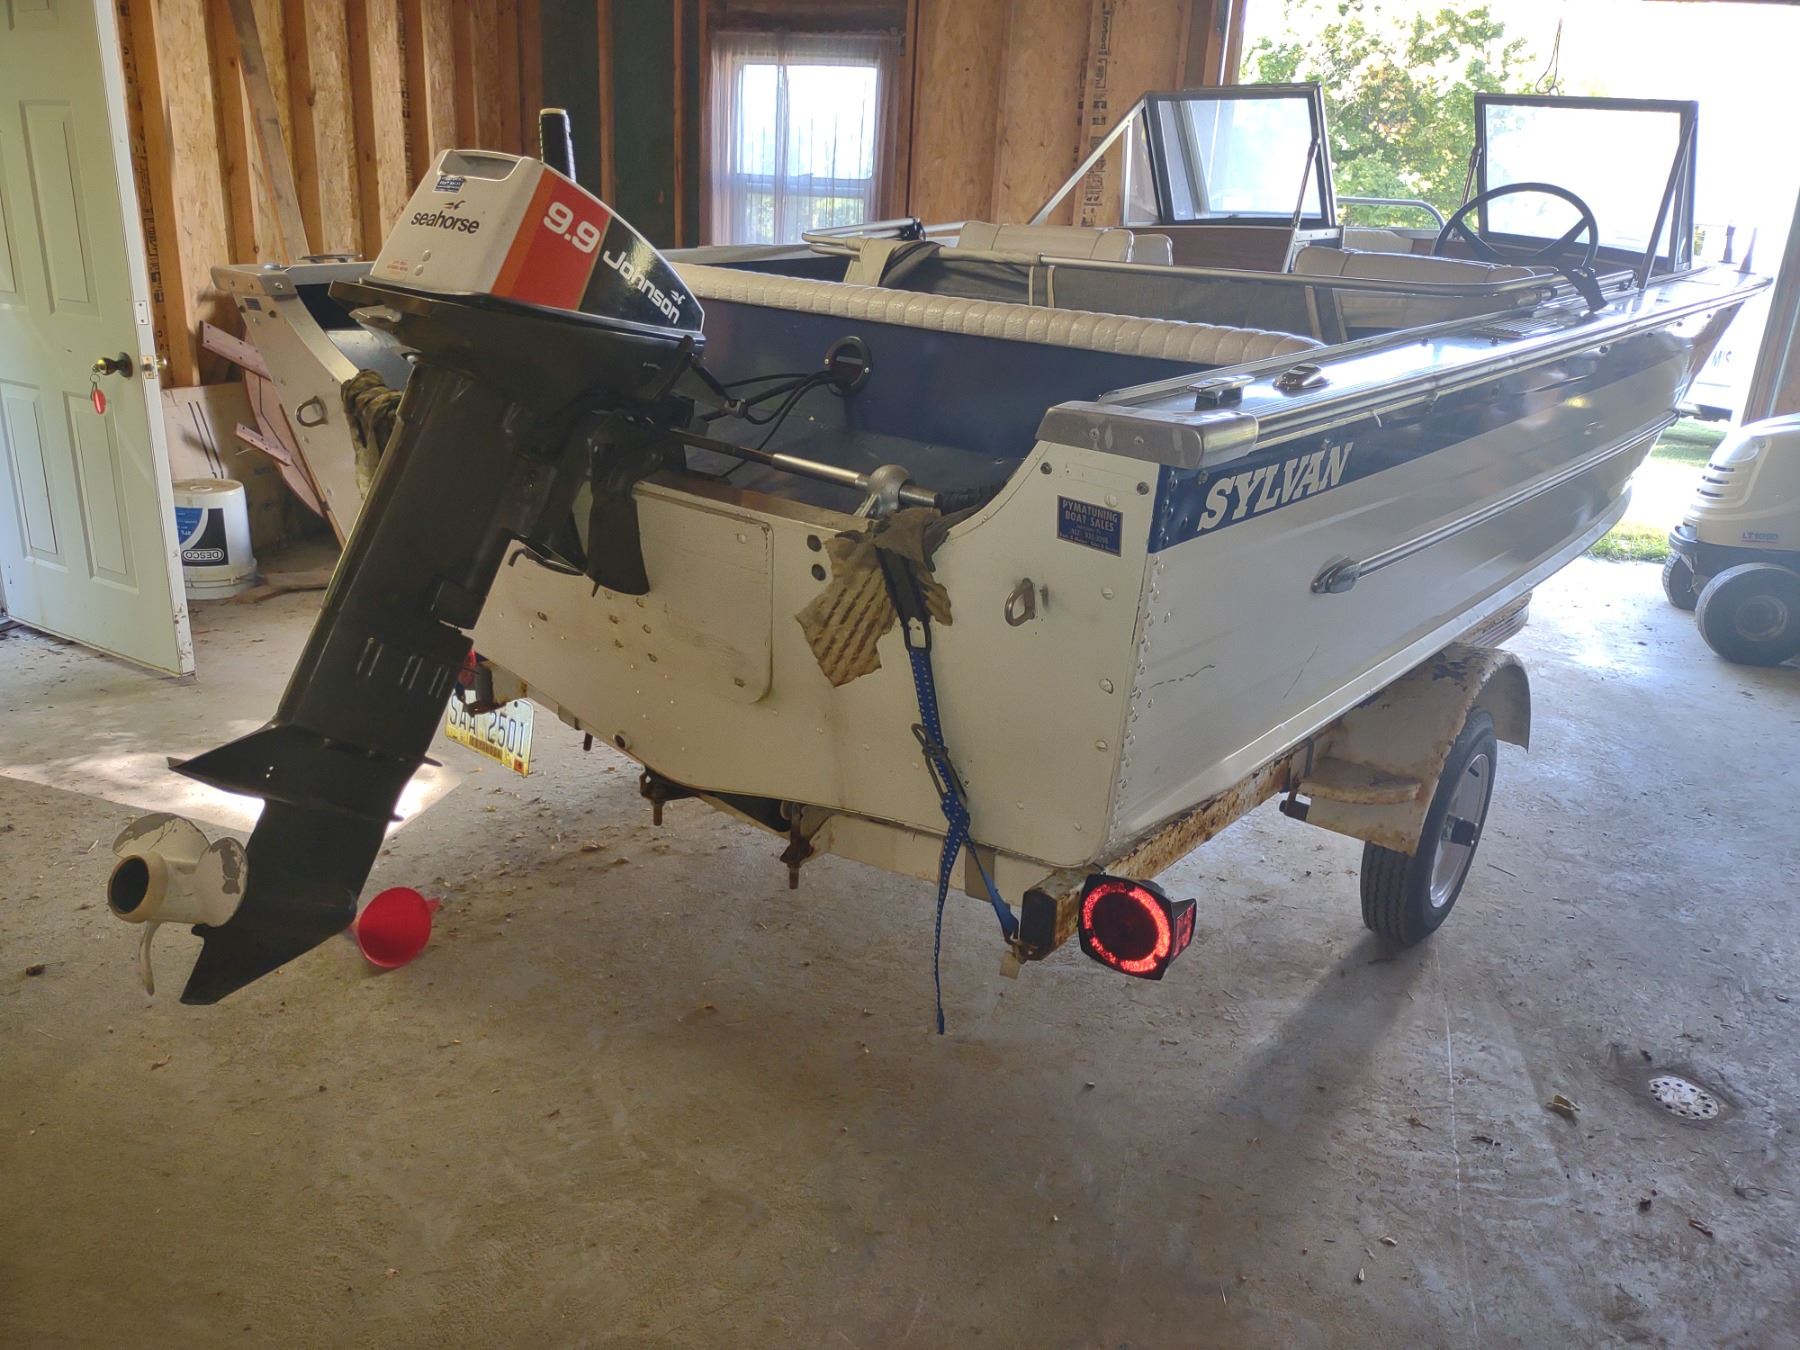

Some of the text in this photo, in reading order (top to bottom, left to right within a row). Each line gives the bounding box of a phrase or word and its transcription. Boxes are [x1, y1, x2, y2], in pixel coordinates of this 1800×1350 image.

[410, 210, 480, 234] seahorse
[543, 201, 600, 254] 9.9
[1197, 442, 1354, 532] SYLVAN
[1062, 499, 1118, 523] PYMATUNING
[1065, 510, 1087, 525] BOAT
[1090, 517, 1115, 532] SALES
[487, 711, 523, 758] 2501
